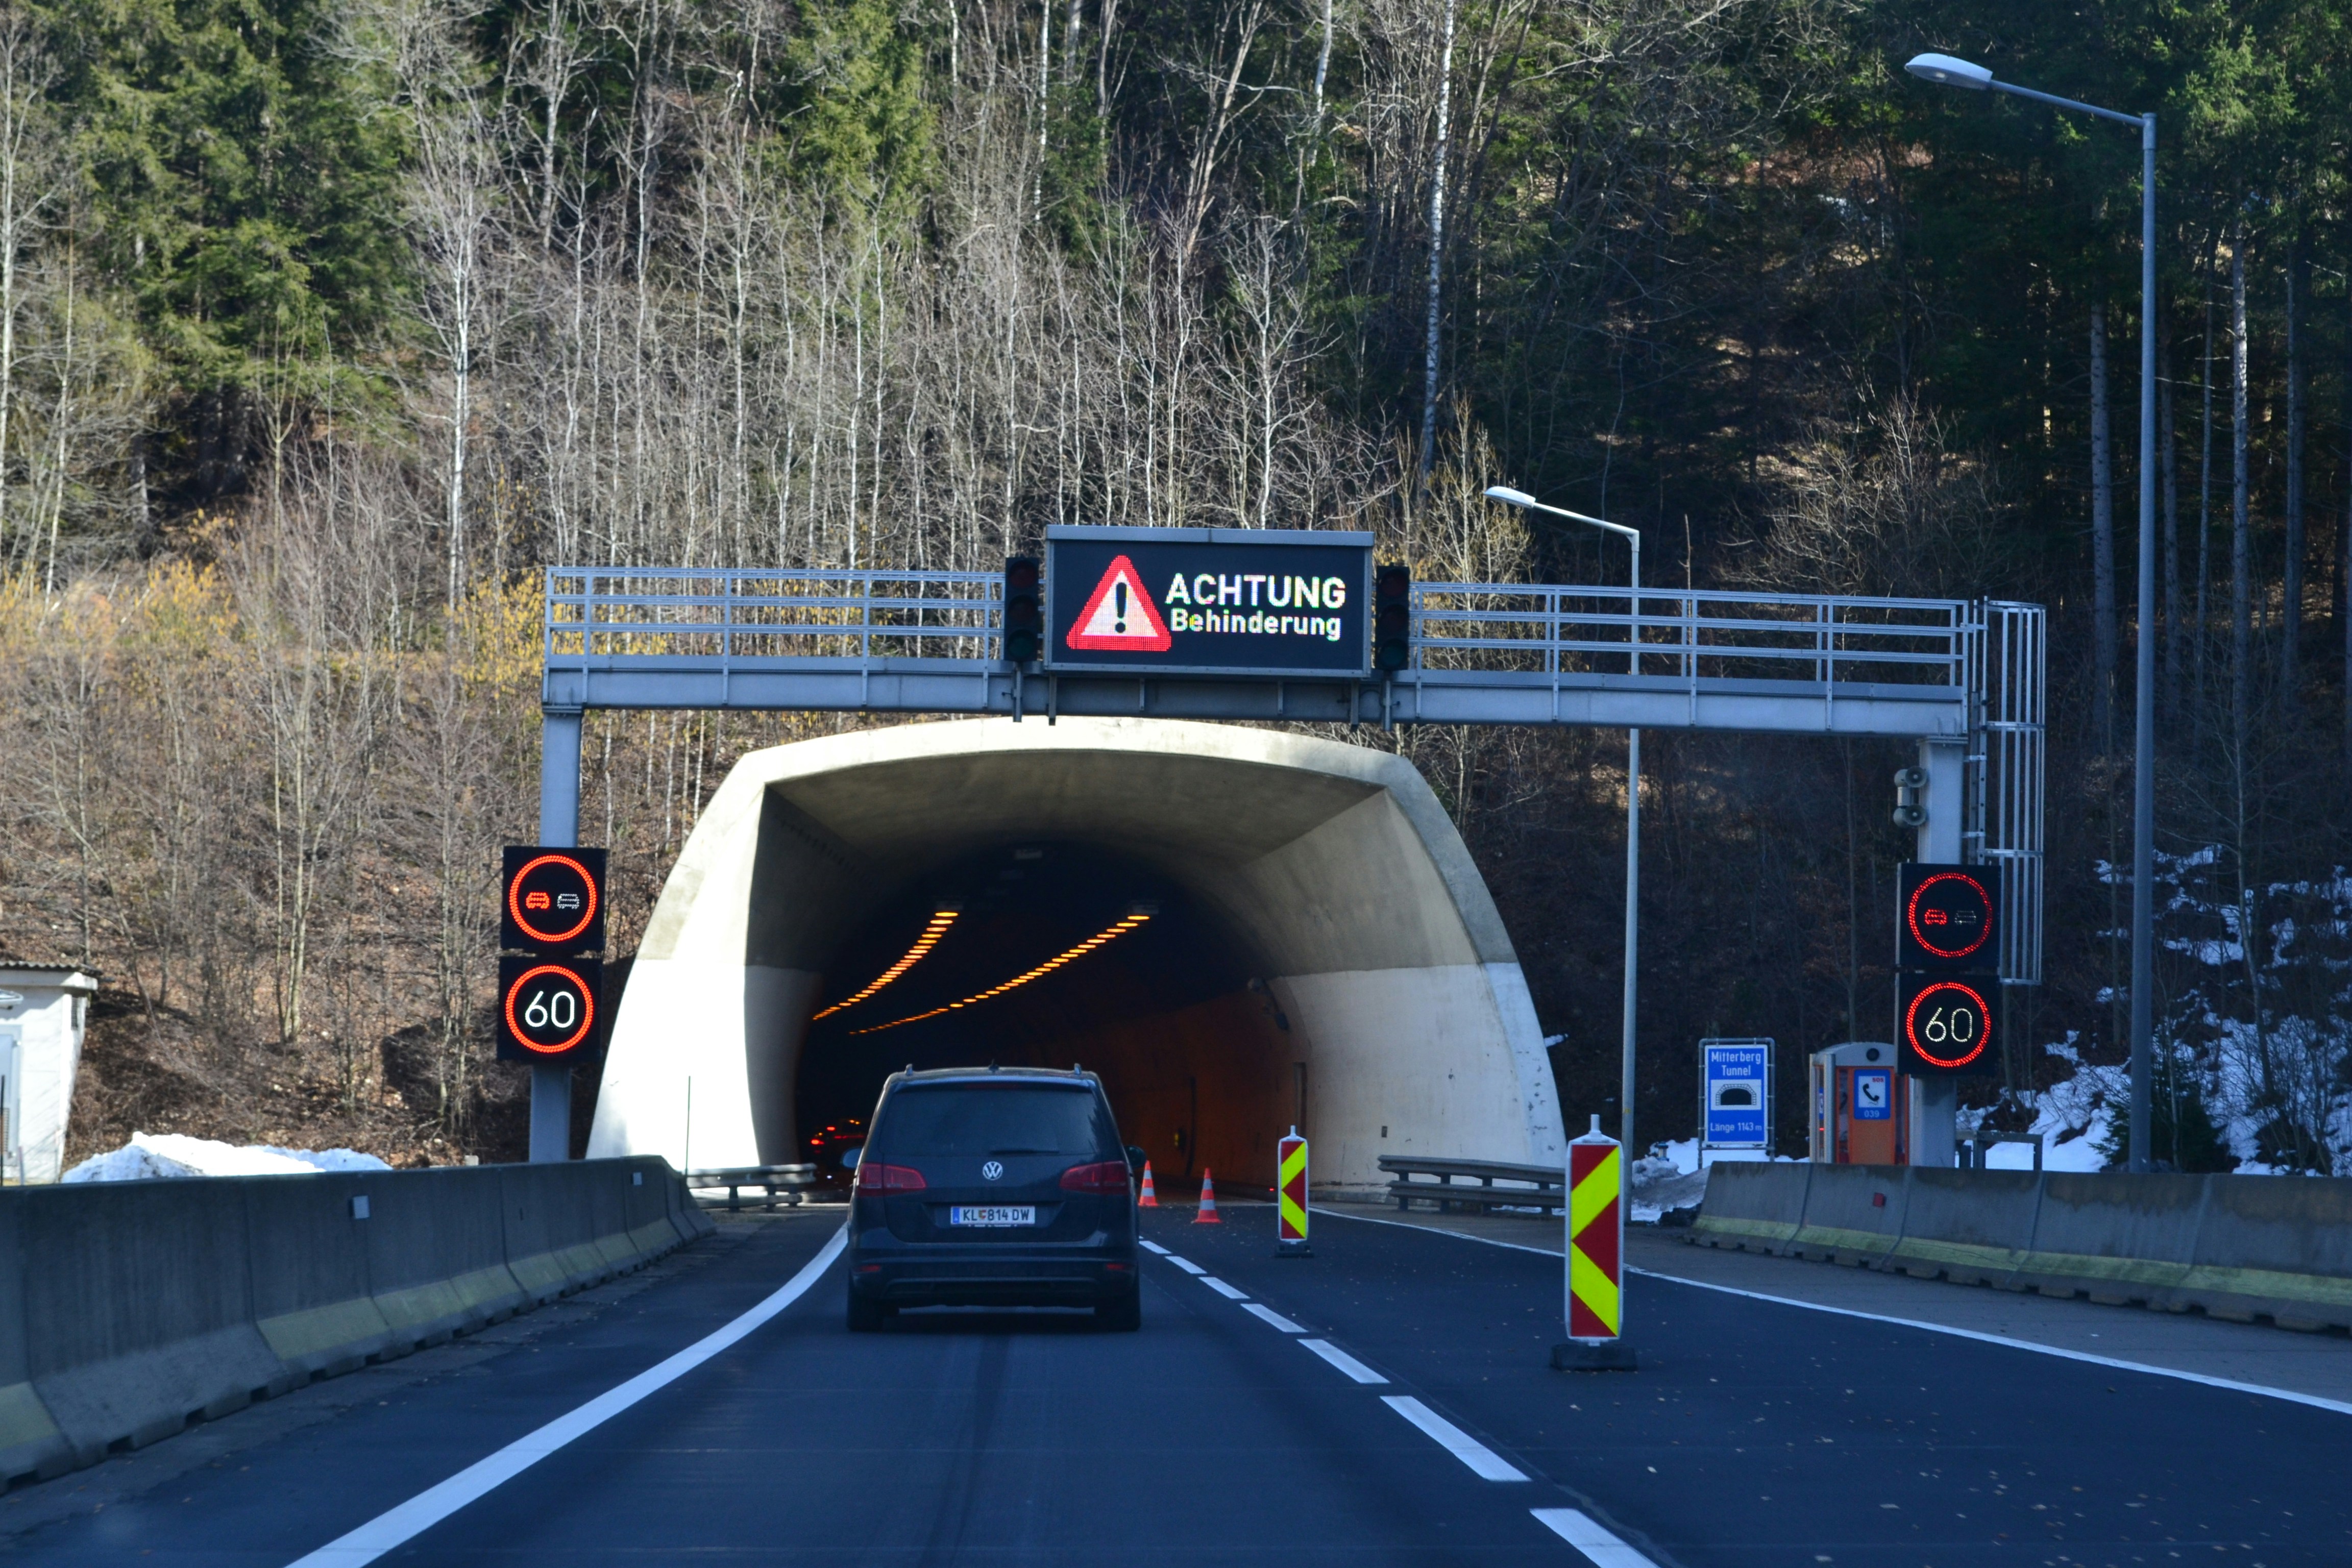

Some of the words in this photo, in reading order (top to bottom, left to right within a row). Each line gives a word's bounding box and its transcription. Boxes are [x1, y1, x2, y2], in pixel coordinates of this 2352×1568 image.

[1165, 573, 1346, 608] ACHTUNG
[1170, 608, 1341, 641] Behinderung
[525, 991, 575, 1027] 60
[1926, 1007, 1973, 1042] 60
[1711, 1051, 1761, 1064] Mitterberg
[1722, 1065, 1751, 1076] Tunnel
[1737, 1122, 1754, 1131] 1143
[963, 1209, 977, 1221] KL
[988, 1209, 1008, 1221] 814
[1012, 1209, 1030, 1220] DW
